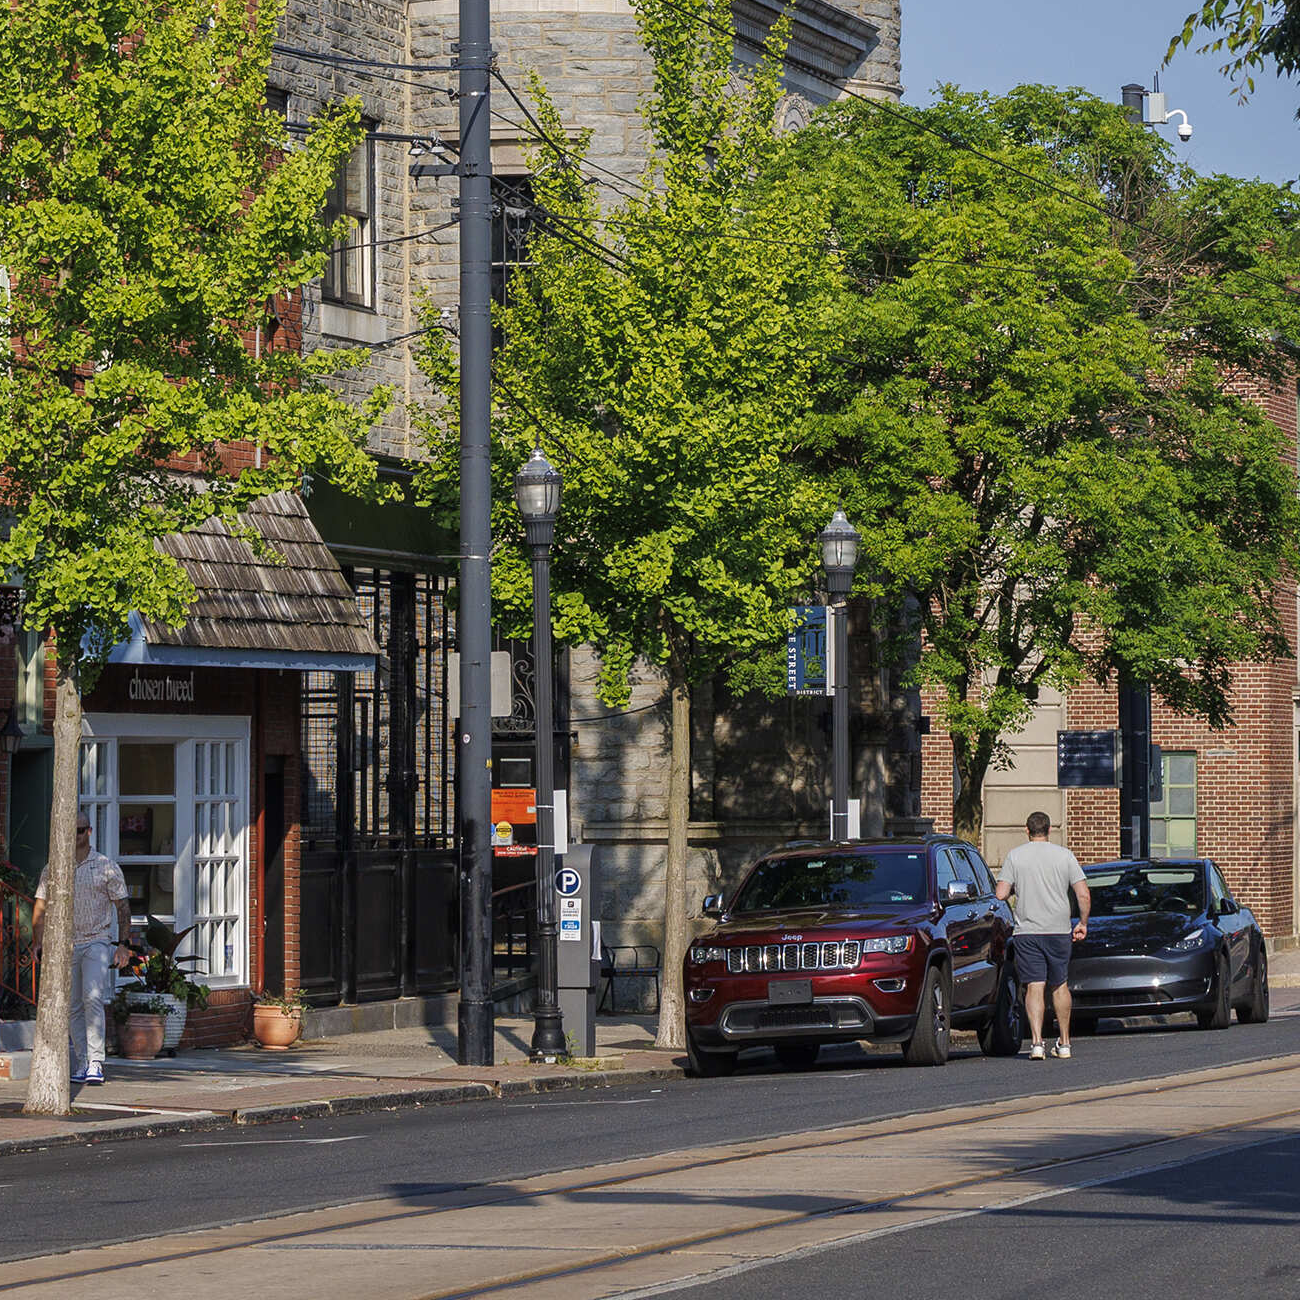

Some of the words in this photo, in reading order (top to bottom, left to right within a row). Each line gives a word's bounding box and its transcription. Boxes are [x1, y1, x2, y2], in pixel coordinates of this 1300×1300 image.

[129, 668, 164, 701] chosen
[166, 671, 194, 701] tweed
[788, 647, 796, 690] STREET
[781, 934, 803, 942] Jeep
